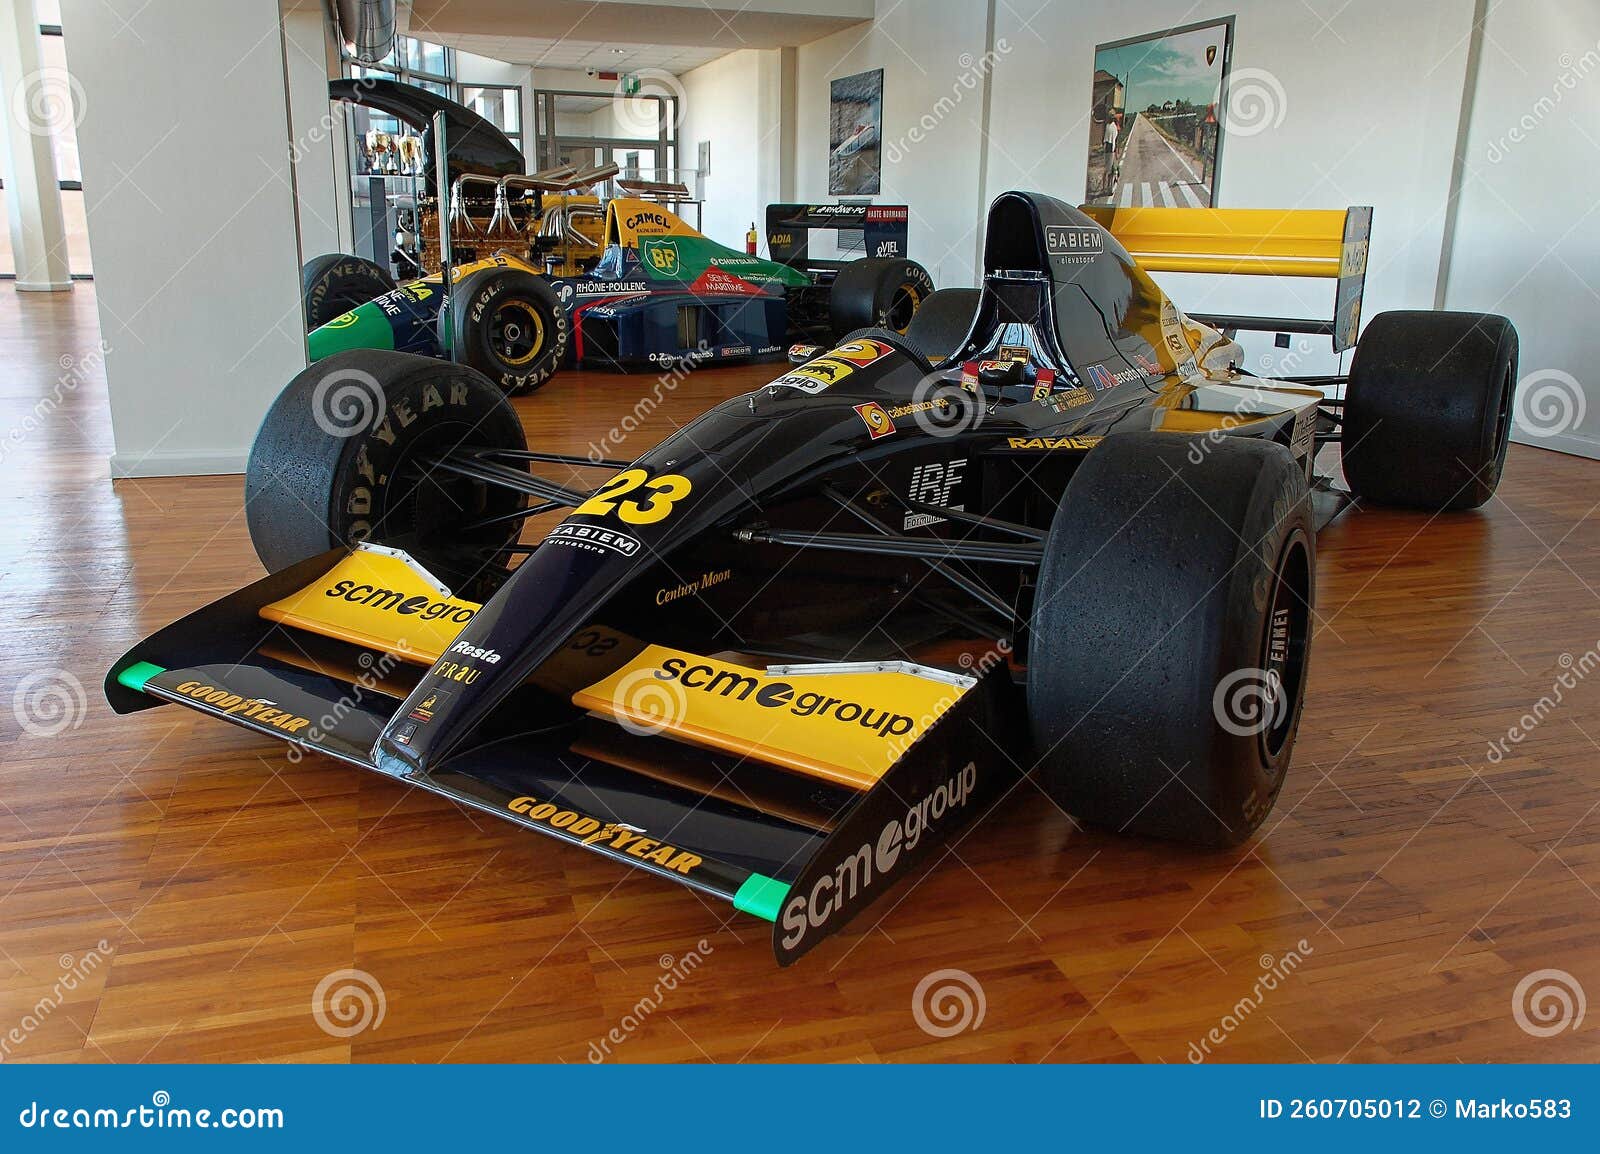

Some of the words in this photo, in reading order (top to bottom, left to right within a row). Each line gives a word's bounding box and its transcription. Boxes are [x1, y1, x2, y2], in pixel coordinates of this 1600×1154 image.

[626, 212, 671, 229] CAMEL
[1048, 232, 1101, 248] SABIEM
[650, 248, 675, 268] BP
[576, 281, 647, 293] RHÔNE-POULENC
[571, 469, 692, 524] 23
[549, 539, 605, 554] elevators
[550, 525, 635, 552] SABIEM
[656, 583, 700, 606] Century
[701, 568, 731, 590] Moon
[450, 640, 501, 665] Resta
[175, 681, 311, 733] GOODYEAR
[507, 796, 703, 874] GOODYEAR
